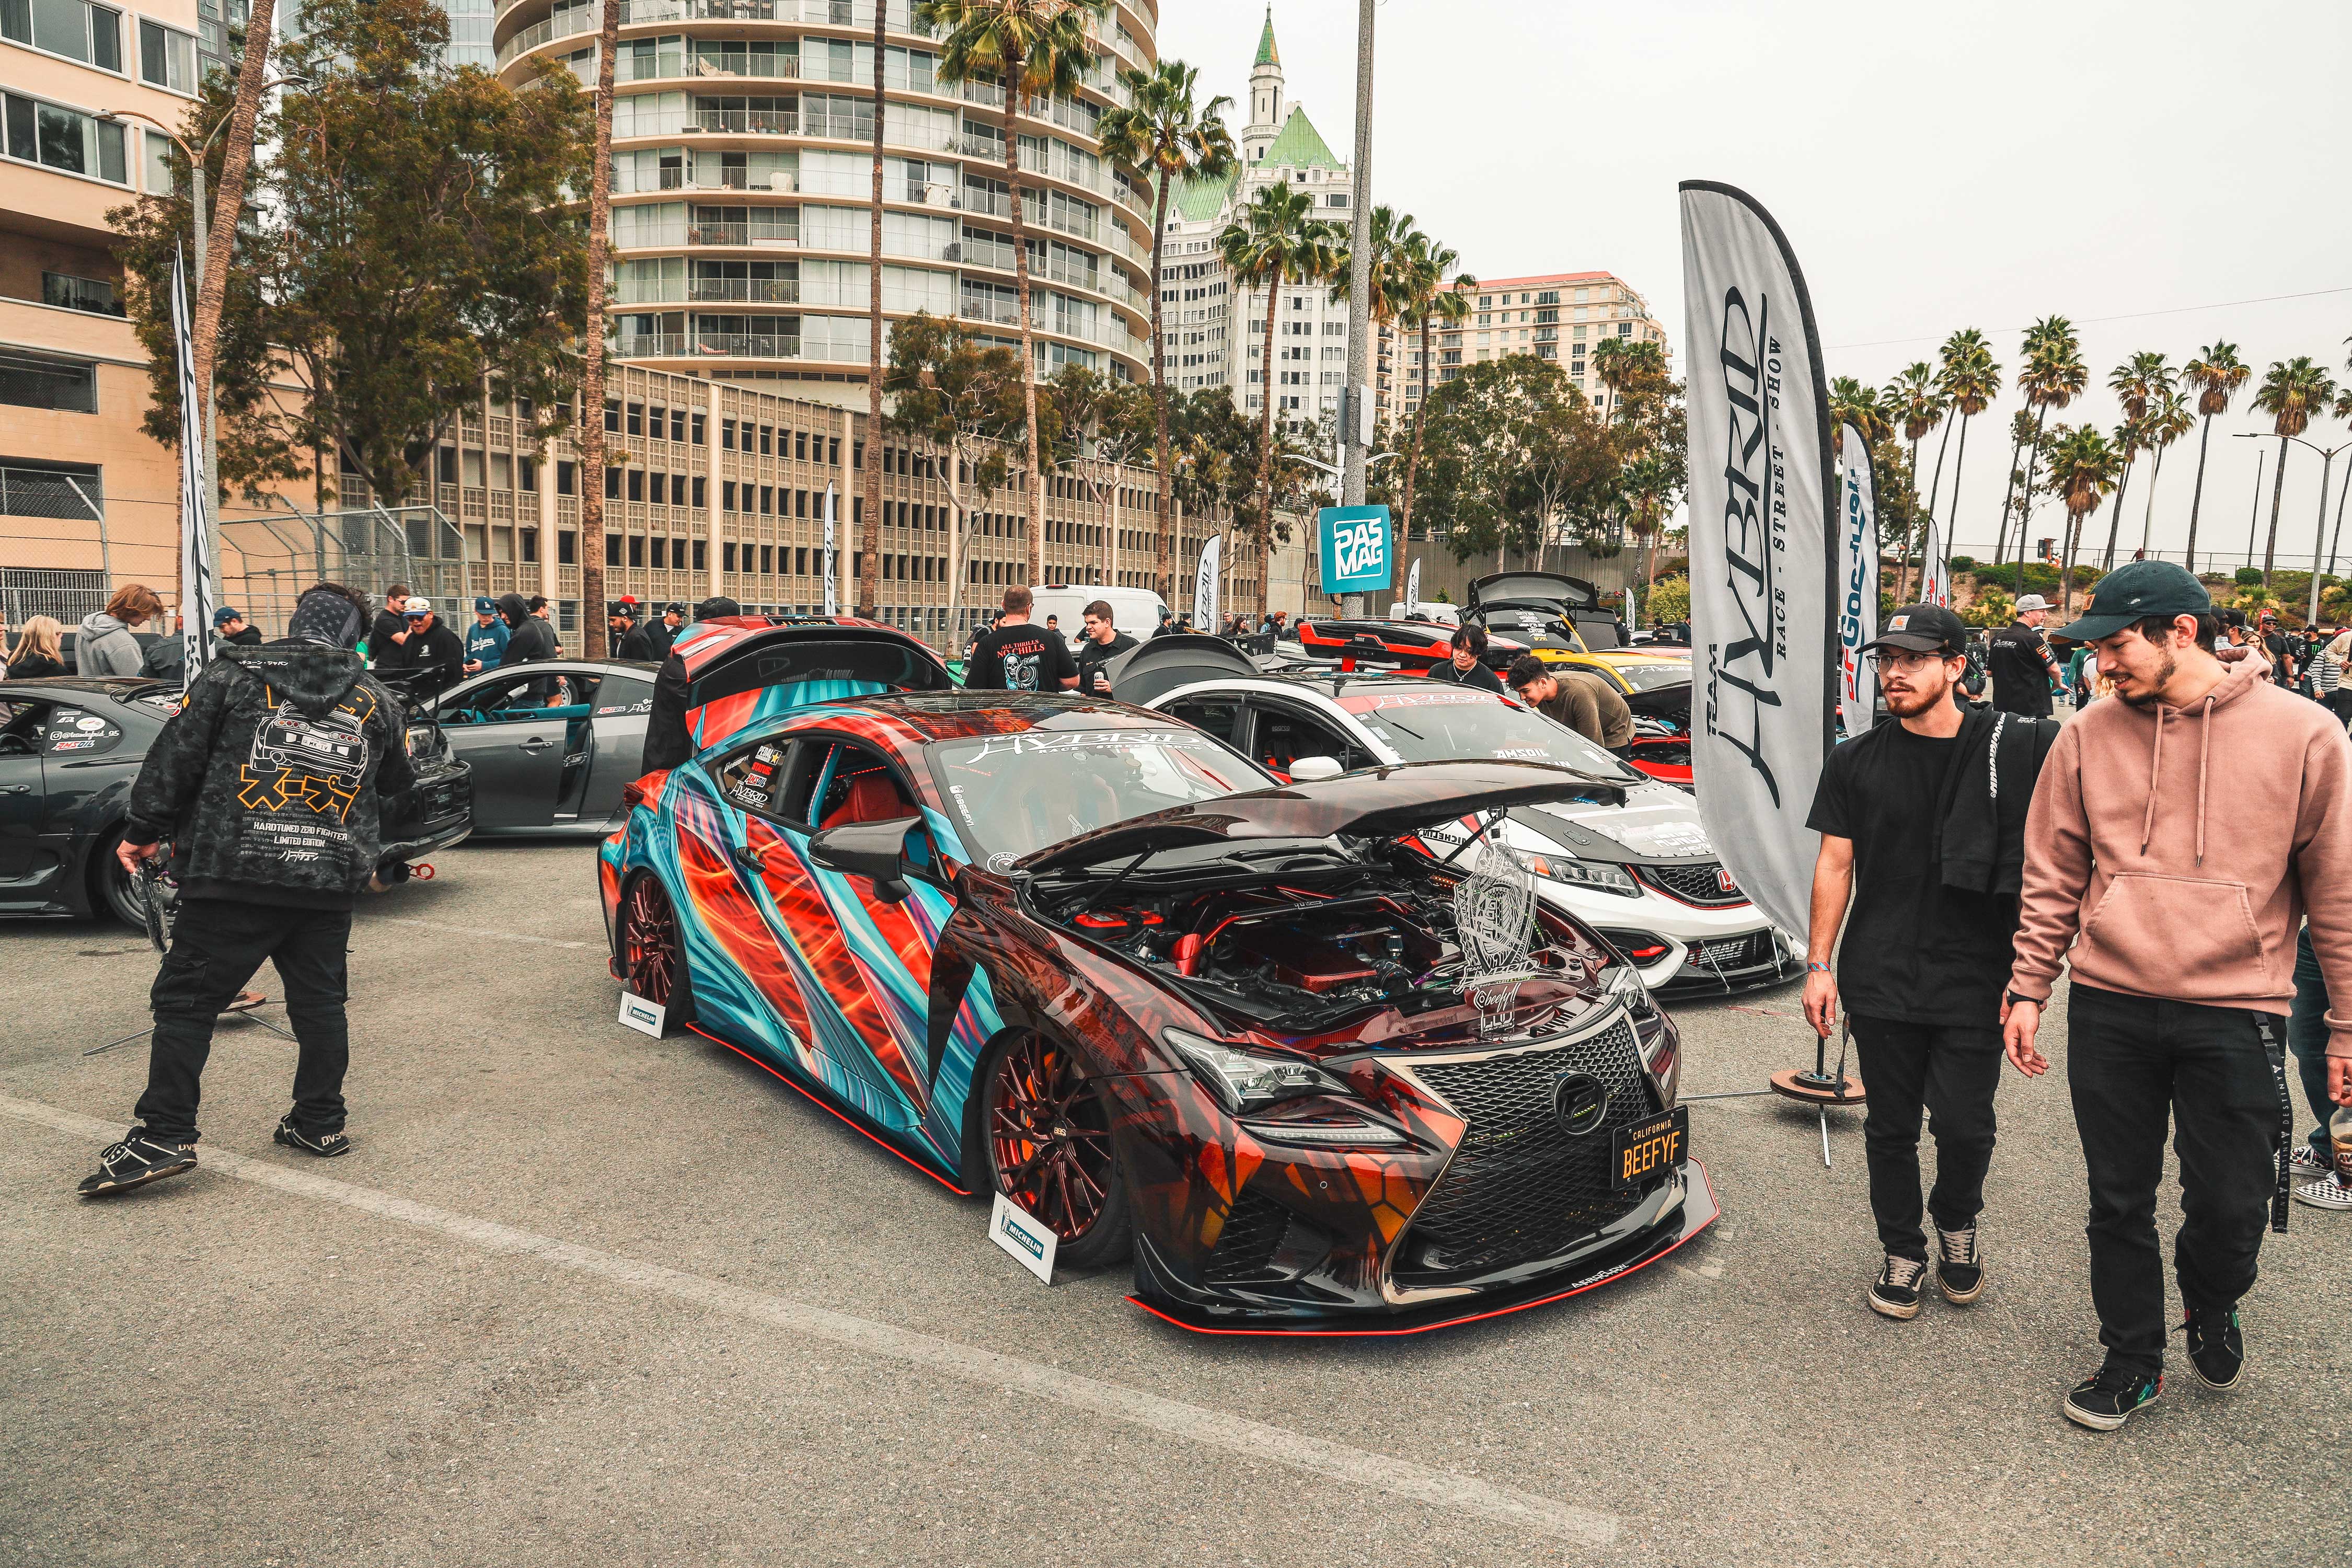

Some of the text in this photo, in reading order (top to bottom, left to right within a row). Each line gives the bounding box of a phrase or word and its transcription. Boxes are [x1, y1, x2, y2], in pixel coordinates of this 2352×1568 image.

[1768, 336, 1786, 661] RACE STREET SHOW
[1335, 544, 1383, 579] MAG
[997, 643, 1045, 659] NO CHILLS
[1016, 639, 1040, 648] THRILLS
[1706, 643, 1719, 737] TEAM
[53, 741, 95, 750] AMSOIL
[757, 745, 774, 758] PEDAL
[1037, 745, 1074, 755] RACE
[1491, 748, 1551, 759] AMSOIL
[745, 774, 766, 787] AMSOIL
[729, 783, 768, 804] HYBRID
[253, 822, 299, 834] HARDTUNED
[301, 825, 314, 835] ZERO
[316, 827, 348, 841] FIGHTER
[274, 836, 326, 847] LIMITED EDITION
[632, 1009, 655, 1022] MICHELIN
[2277, 1076, 2289, 1125] DESTINY
[1054, 1127, 1067, 1137] BBS
[1633, 1119, 1671, 1141] CALIFORNIA
[1623, 1131, 1680, 1179] BEEFYF
[2280, 1140, 2289, 1181] DESTINY
[2277, 1195, 2287, 1227] ESTINY
[1009, 1224, 1042, 1254] MICHELIN
[1571, 1264, 1629, 1288] AEROFLOW
